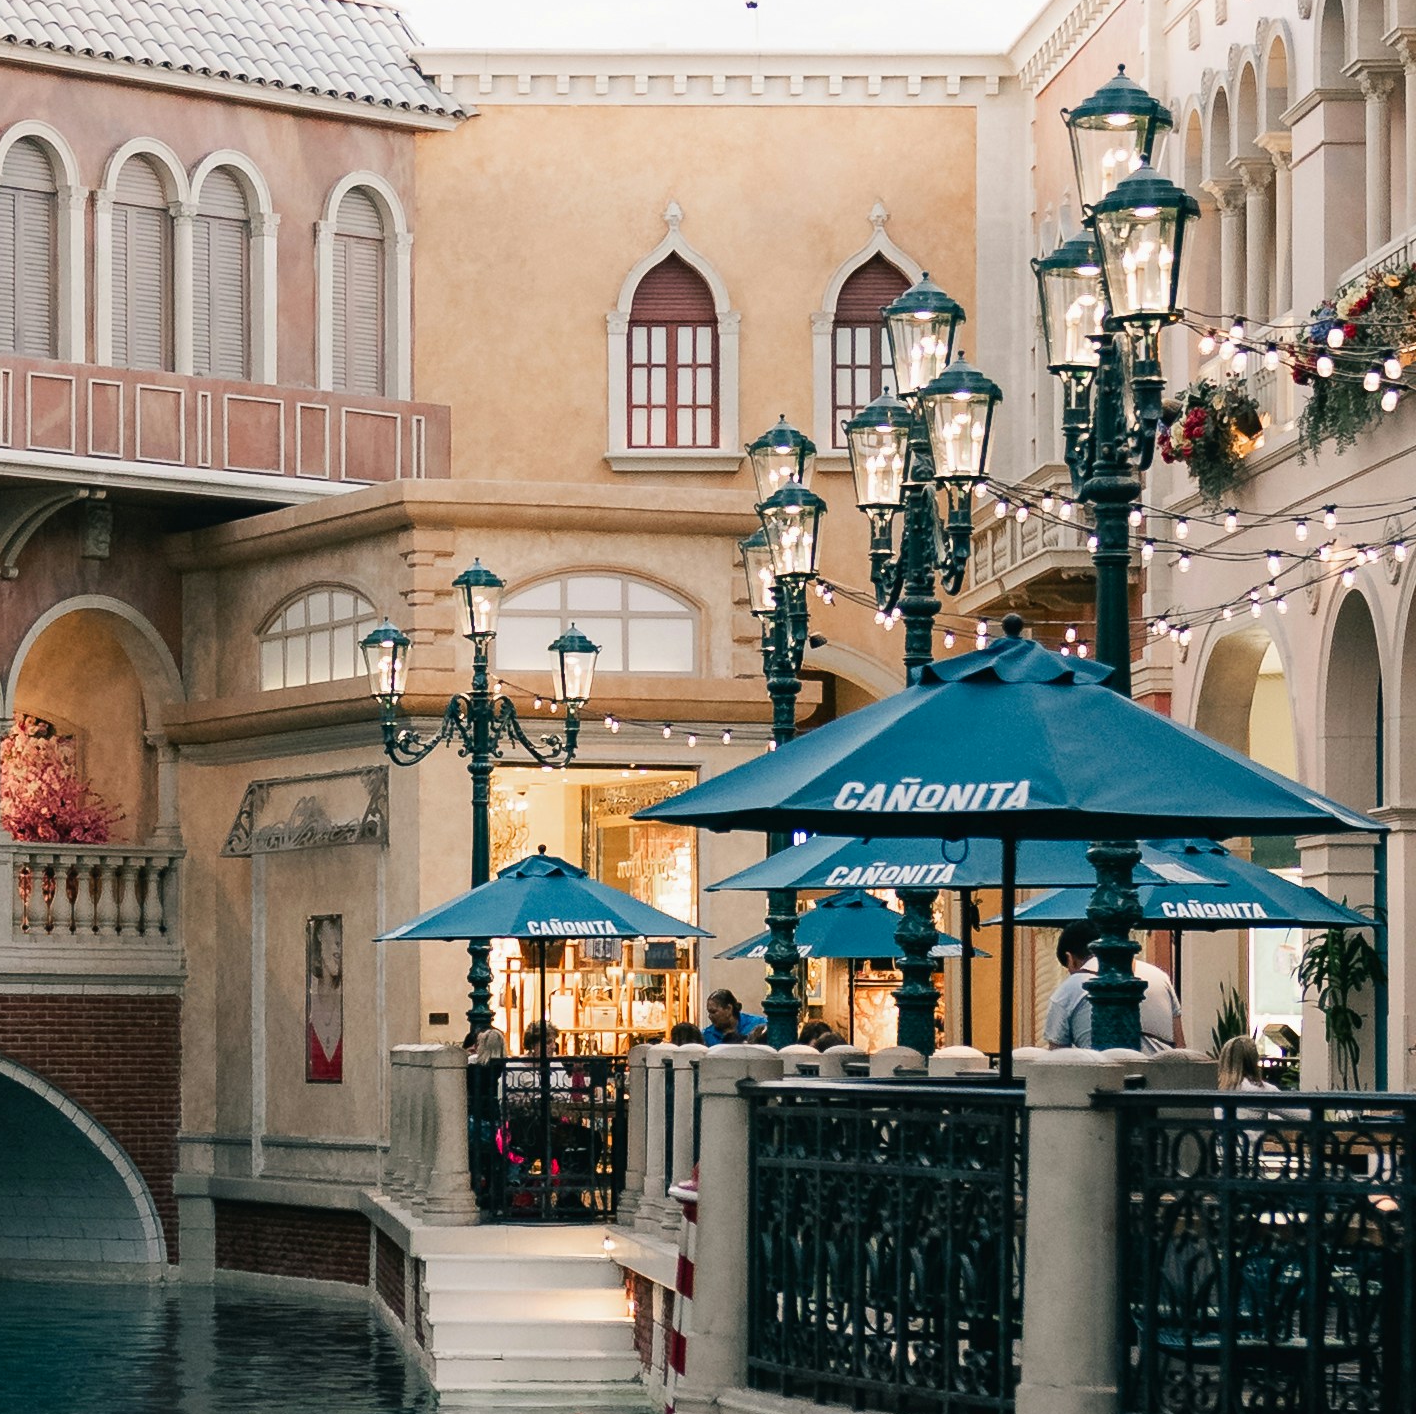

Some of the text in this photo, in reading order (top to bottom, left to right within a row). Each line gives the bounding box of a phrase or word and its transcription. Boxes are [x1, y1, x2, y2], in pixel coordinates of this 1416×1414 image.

[833, 777, 1032, 812] CAÑONITA
[824, 862, 957, 886] CAÑONITA
[1161, 899, 1269, 919] CAÑONITA
[526, 918, 619, 936] CAÑONITA
